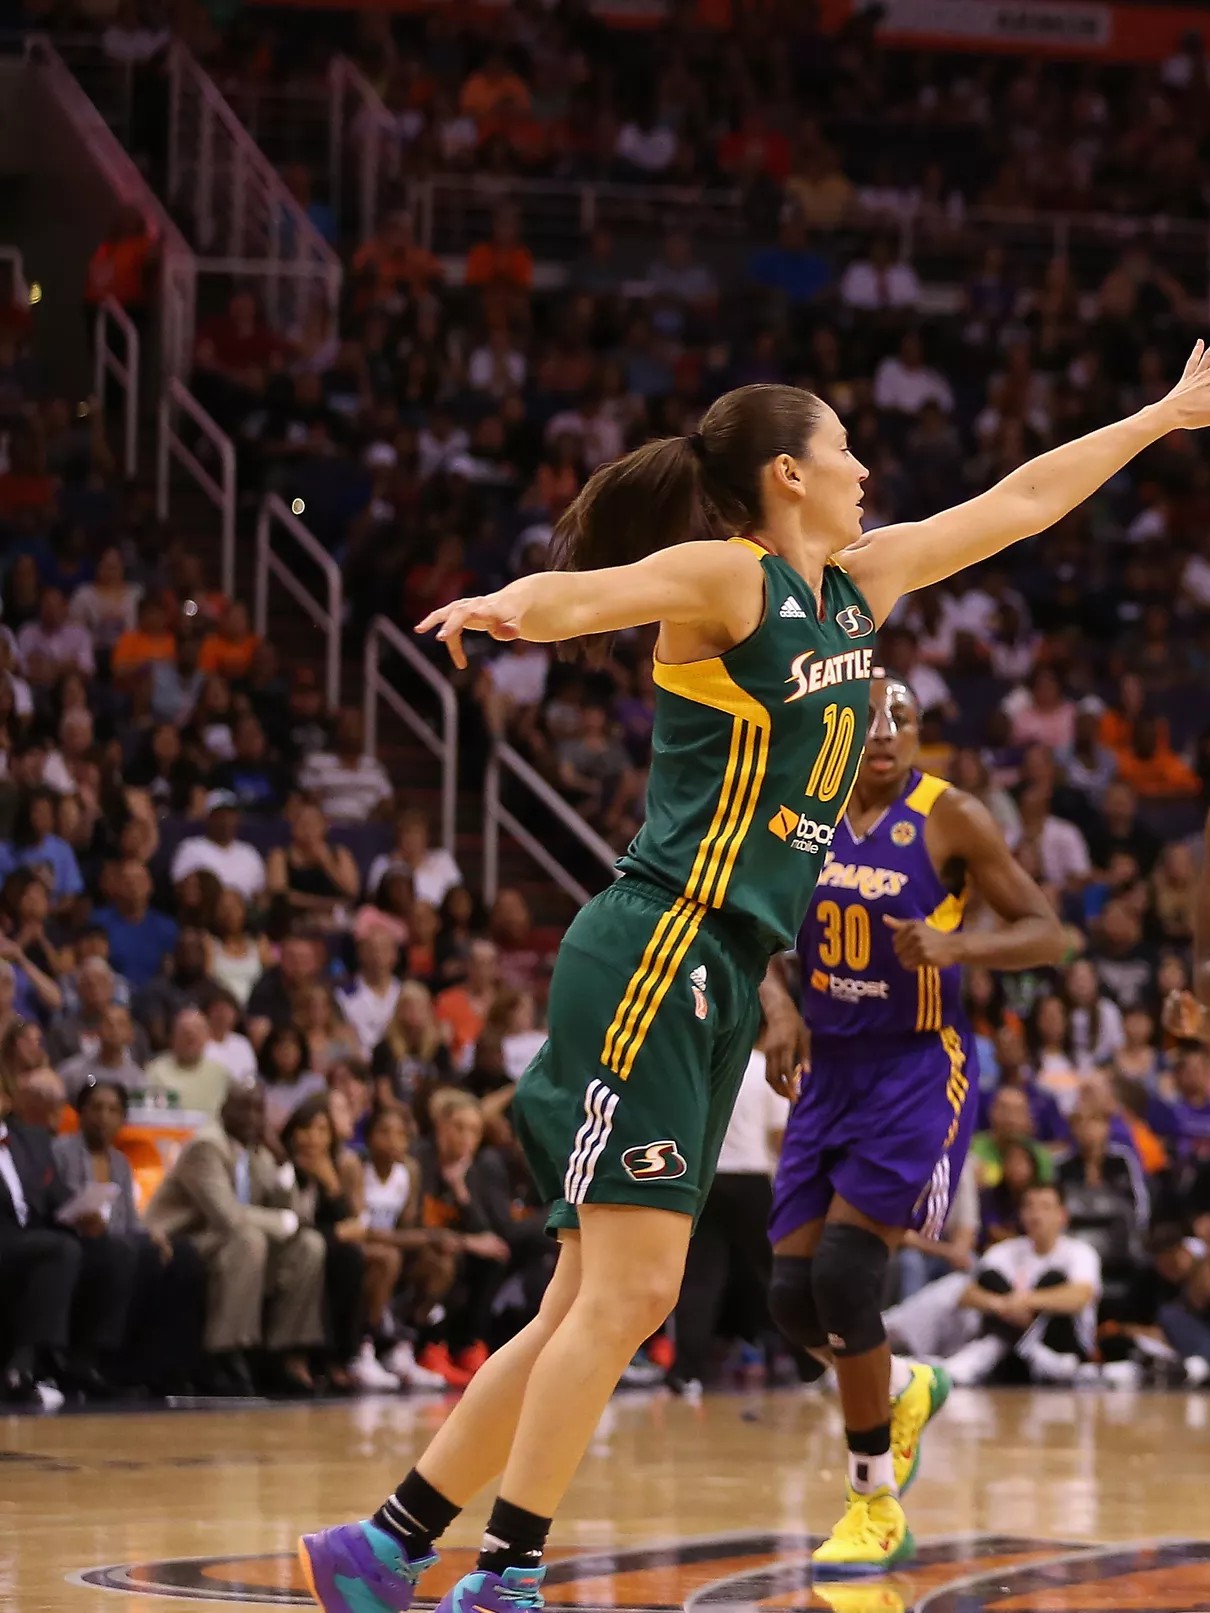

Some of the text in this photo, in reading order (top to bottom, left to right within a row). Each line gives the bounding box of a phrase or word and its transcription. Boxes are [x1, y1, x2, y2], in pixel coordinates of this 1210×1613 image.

[784, 648, 873, 704] SEATTLE
[805, 703, 855, 802] 10
[796, 813, 835, 847] boo
[816, 900, 872, 971] 30
